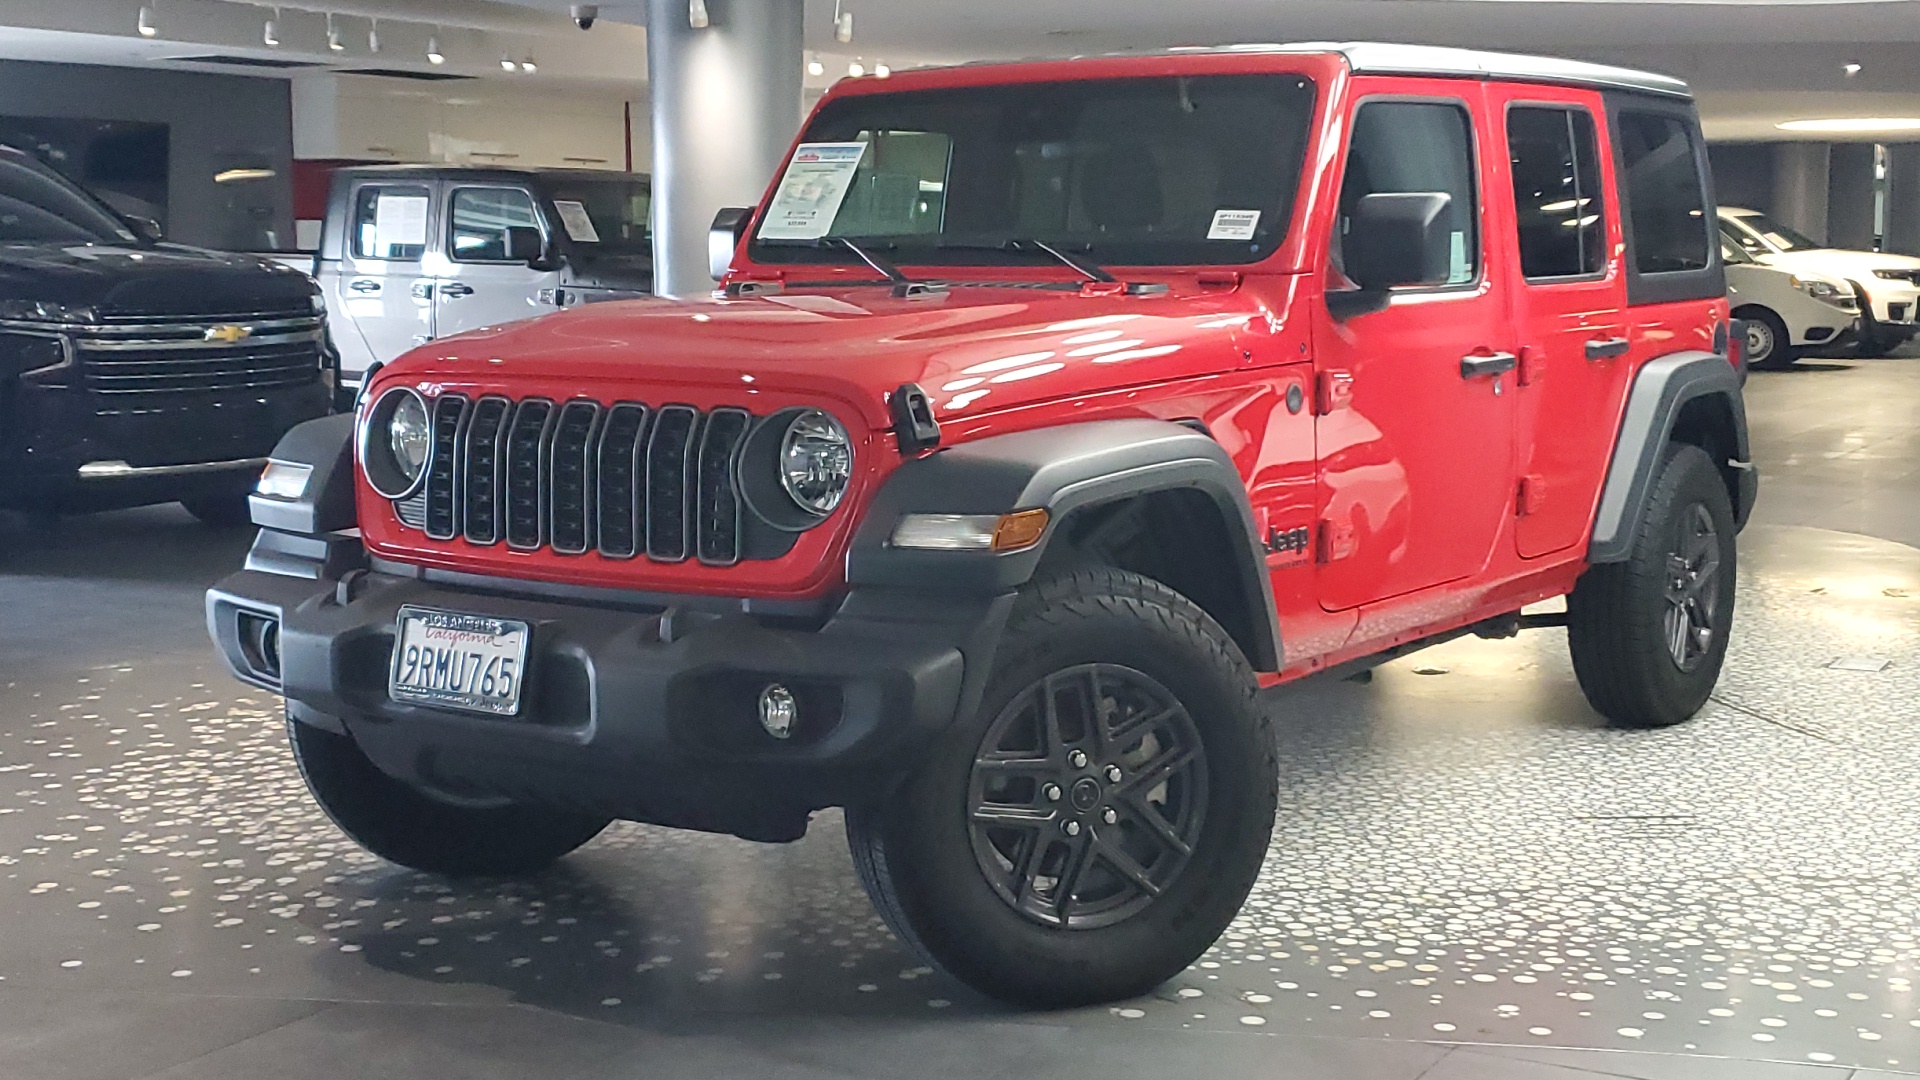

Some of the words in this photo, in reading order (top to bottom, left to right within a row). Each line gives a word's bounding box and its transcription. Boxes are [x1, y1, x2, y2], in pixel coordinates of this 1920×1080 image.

[1262, 525, 1309, 555] Jeep
[425, 626, 503, 648] California
[402, 644, 515, 698] 9RMU765
